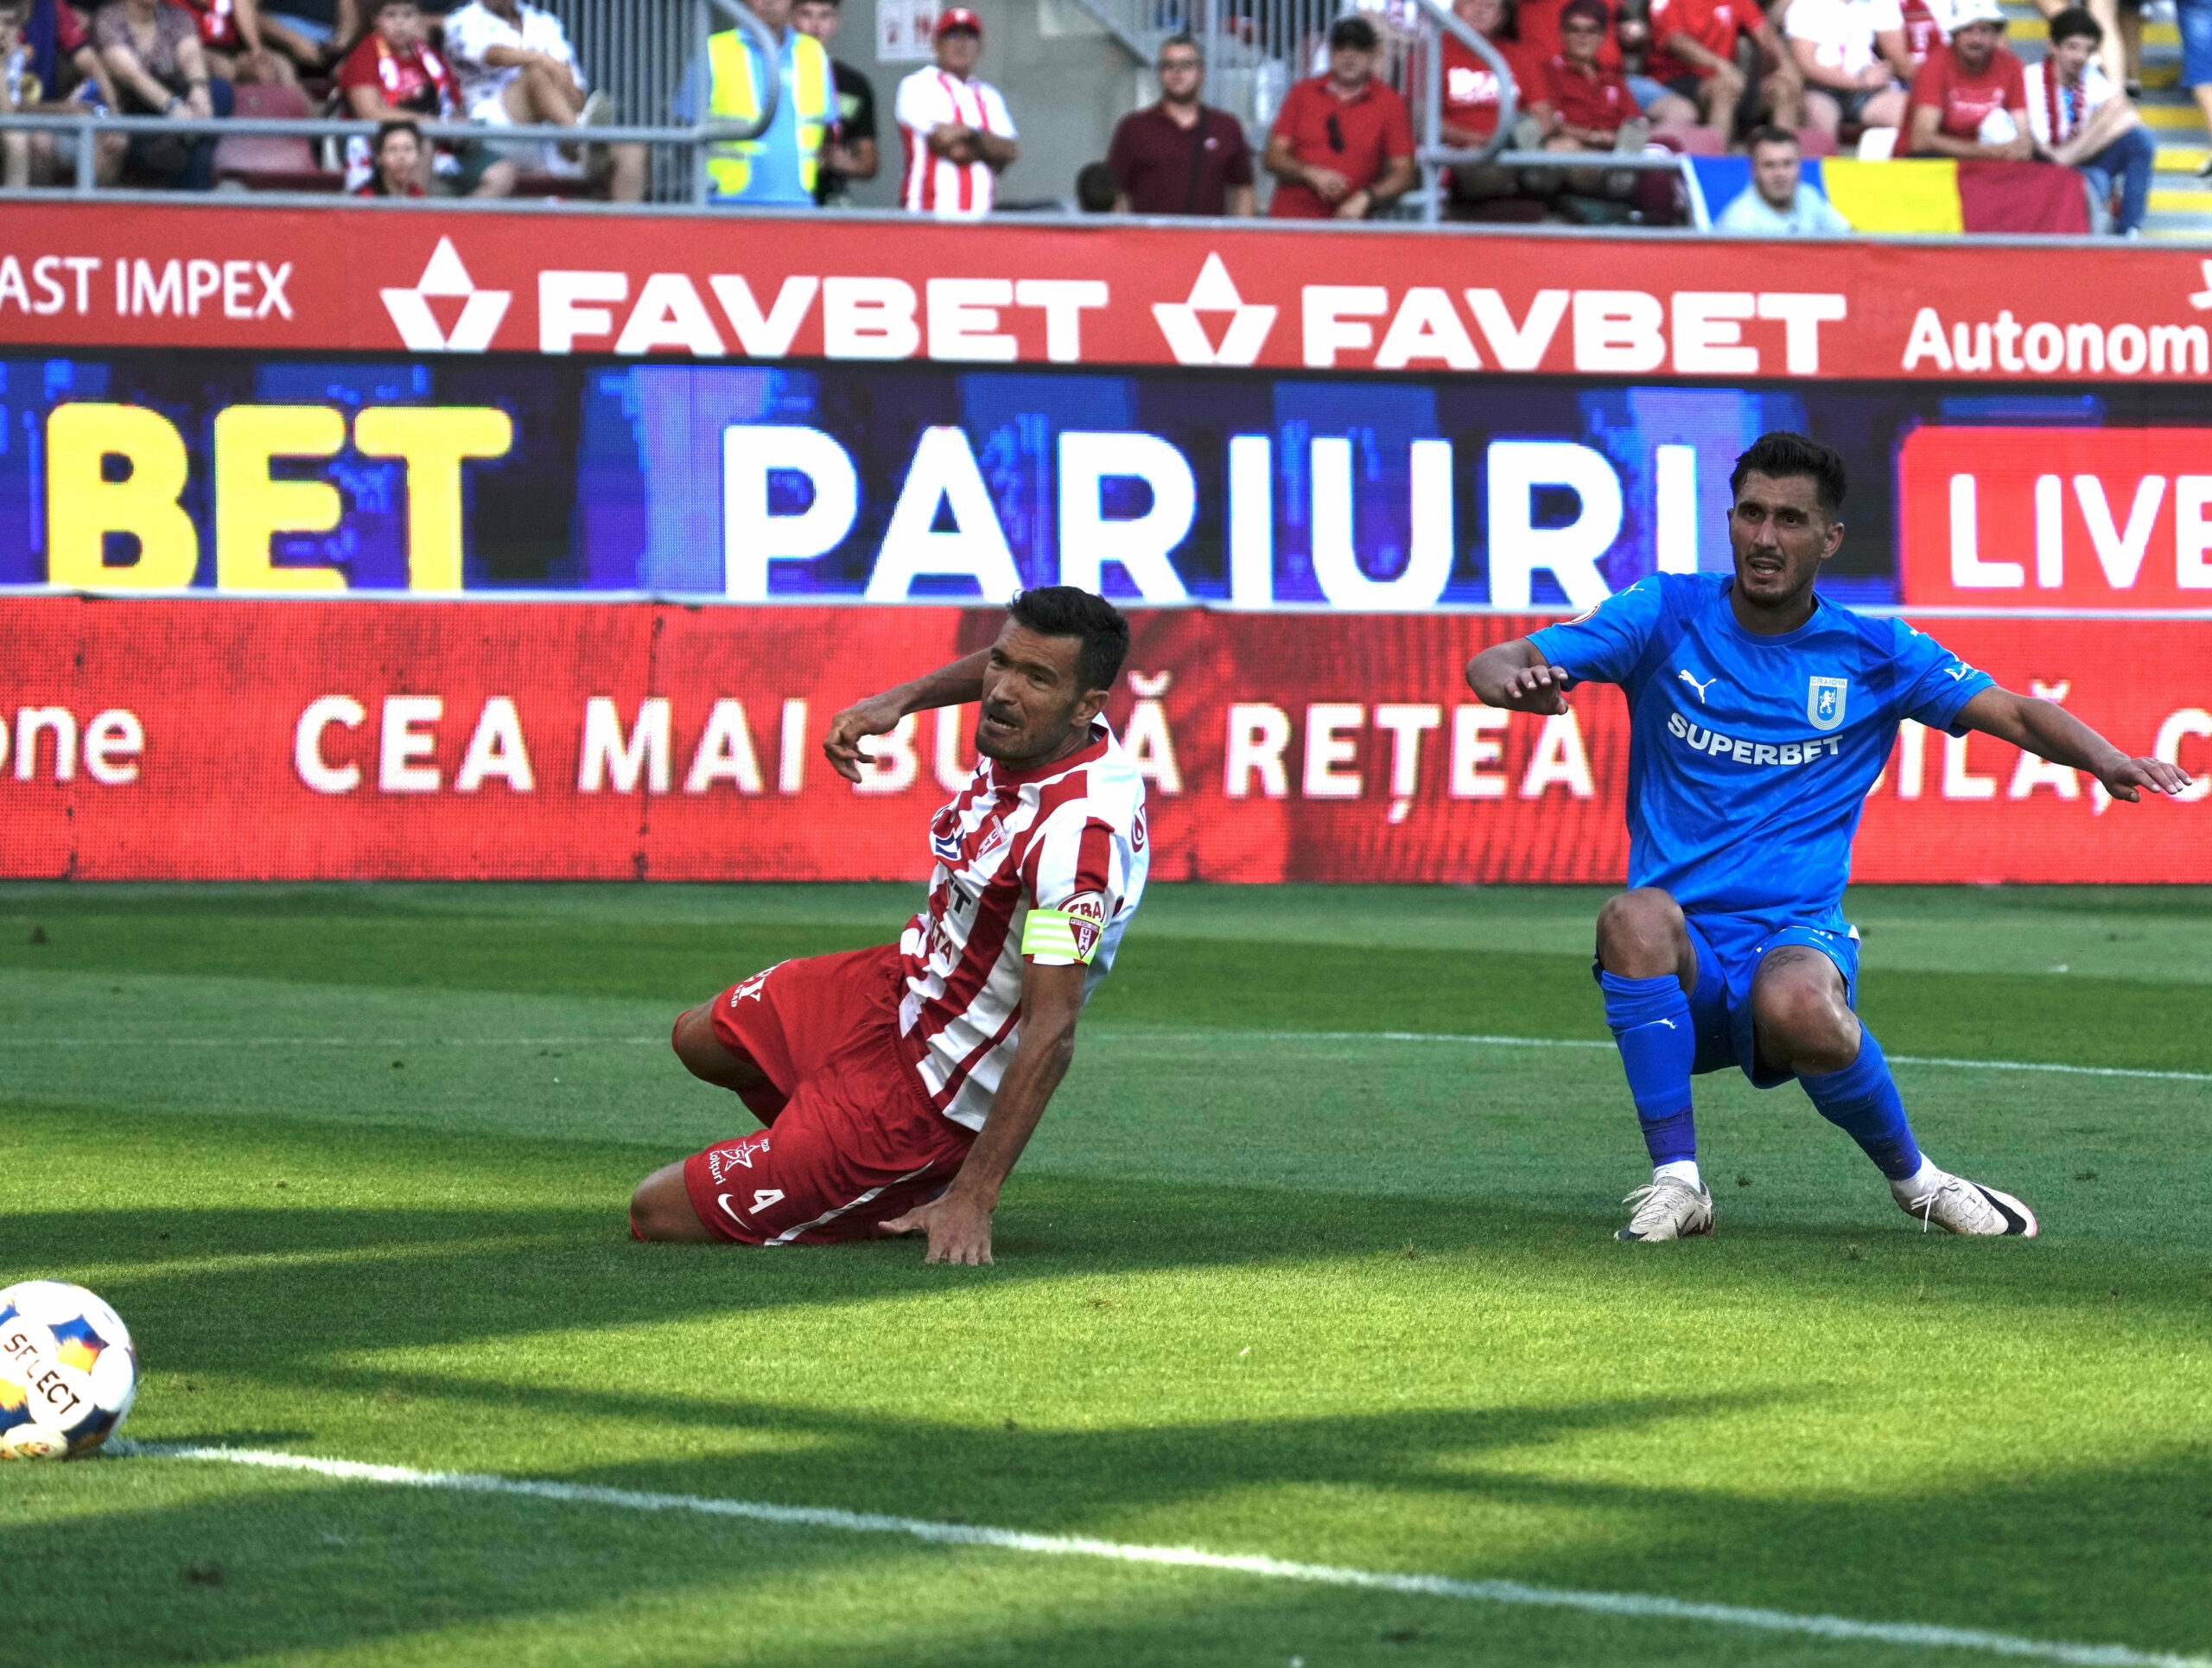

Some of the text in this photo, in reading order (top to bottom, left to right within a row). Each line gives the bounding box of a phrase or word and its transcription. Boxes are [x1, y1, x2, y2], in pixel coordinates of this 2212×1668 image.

[0, 255, 295, 320] AST IMPEX
[537, 269, 1110, 363] FAVBET
[1300, 283, 1848, 375] FAVBET
[1901, 305, 2212, 375] Autonom
[47, 401, 1699, 610] BET PARIURI
[0, 705, 144, 785] ne
[294, 693, 535, 794] CEA
[577, 695, 808, 794] MAI
[850, 672, 1184, 797] BUĂ
[1667, 712, 1843, 766] SUPERBET
[748, 1188, 785, 1215] 4
